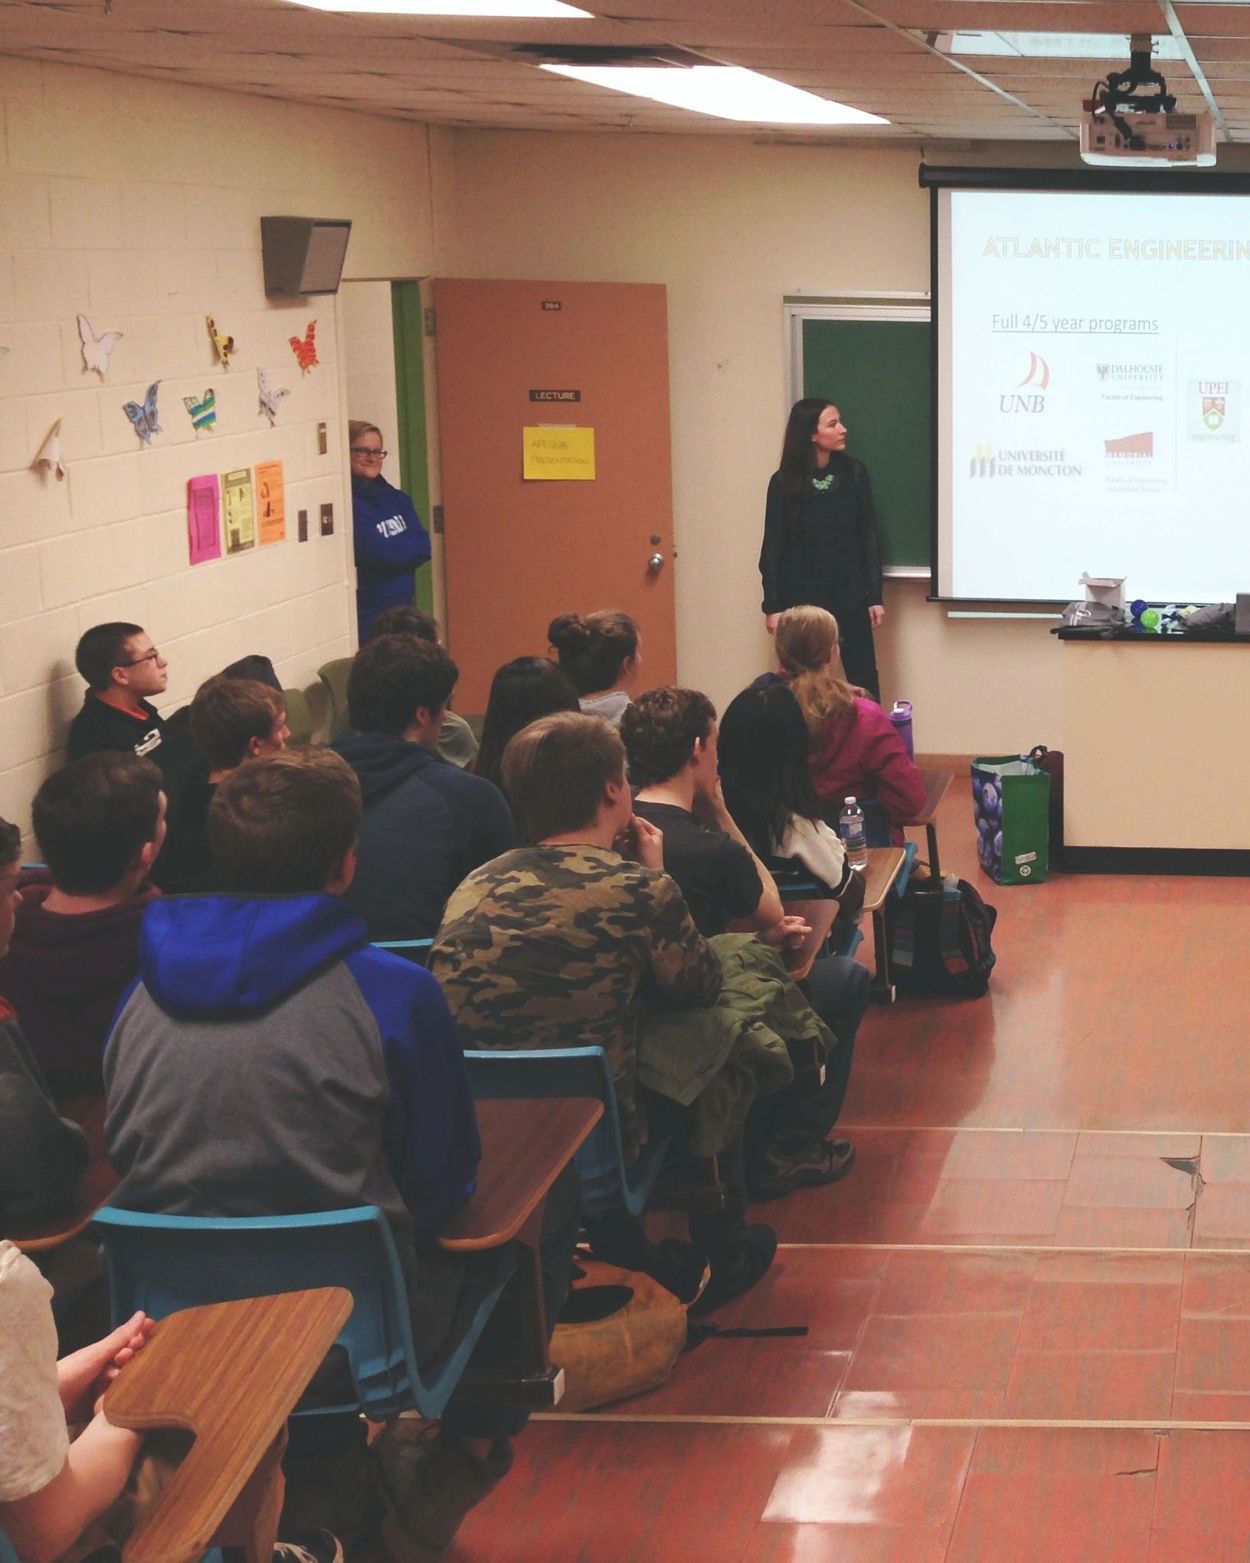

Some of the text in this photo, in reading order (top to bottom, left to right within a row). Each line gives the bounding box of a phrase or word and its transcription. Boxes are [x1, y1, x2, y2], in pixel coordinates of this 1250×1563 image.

[982, 235, 1100, 259] ATLANTIC
[991, 313, 1159, 334] Full 4/5 year programs
[1110, 363, 1164, 374] DALHOUSIE
[1198, 381, 1229, 395] UPEI
[535, 391, 576, 401] LECTURE
[999, 394, 1046, 414] UNB
[998, 446, 1066, 463] UNIVERSITÉ
[998, 464, 1082, 478] DE MONCTON
